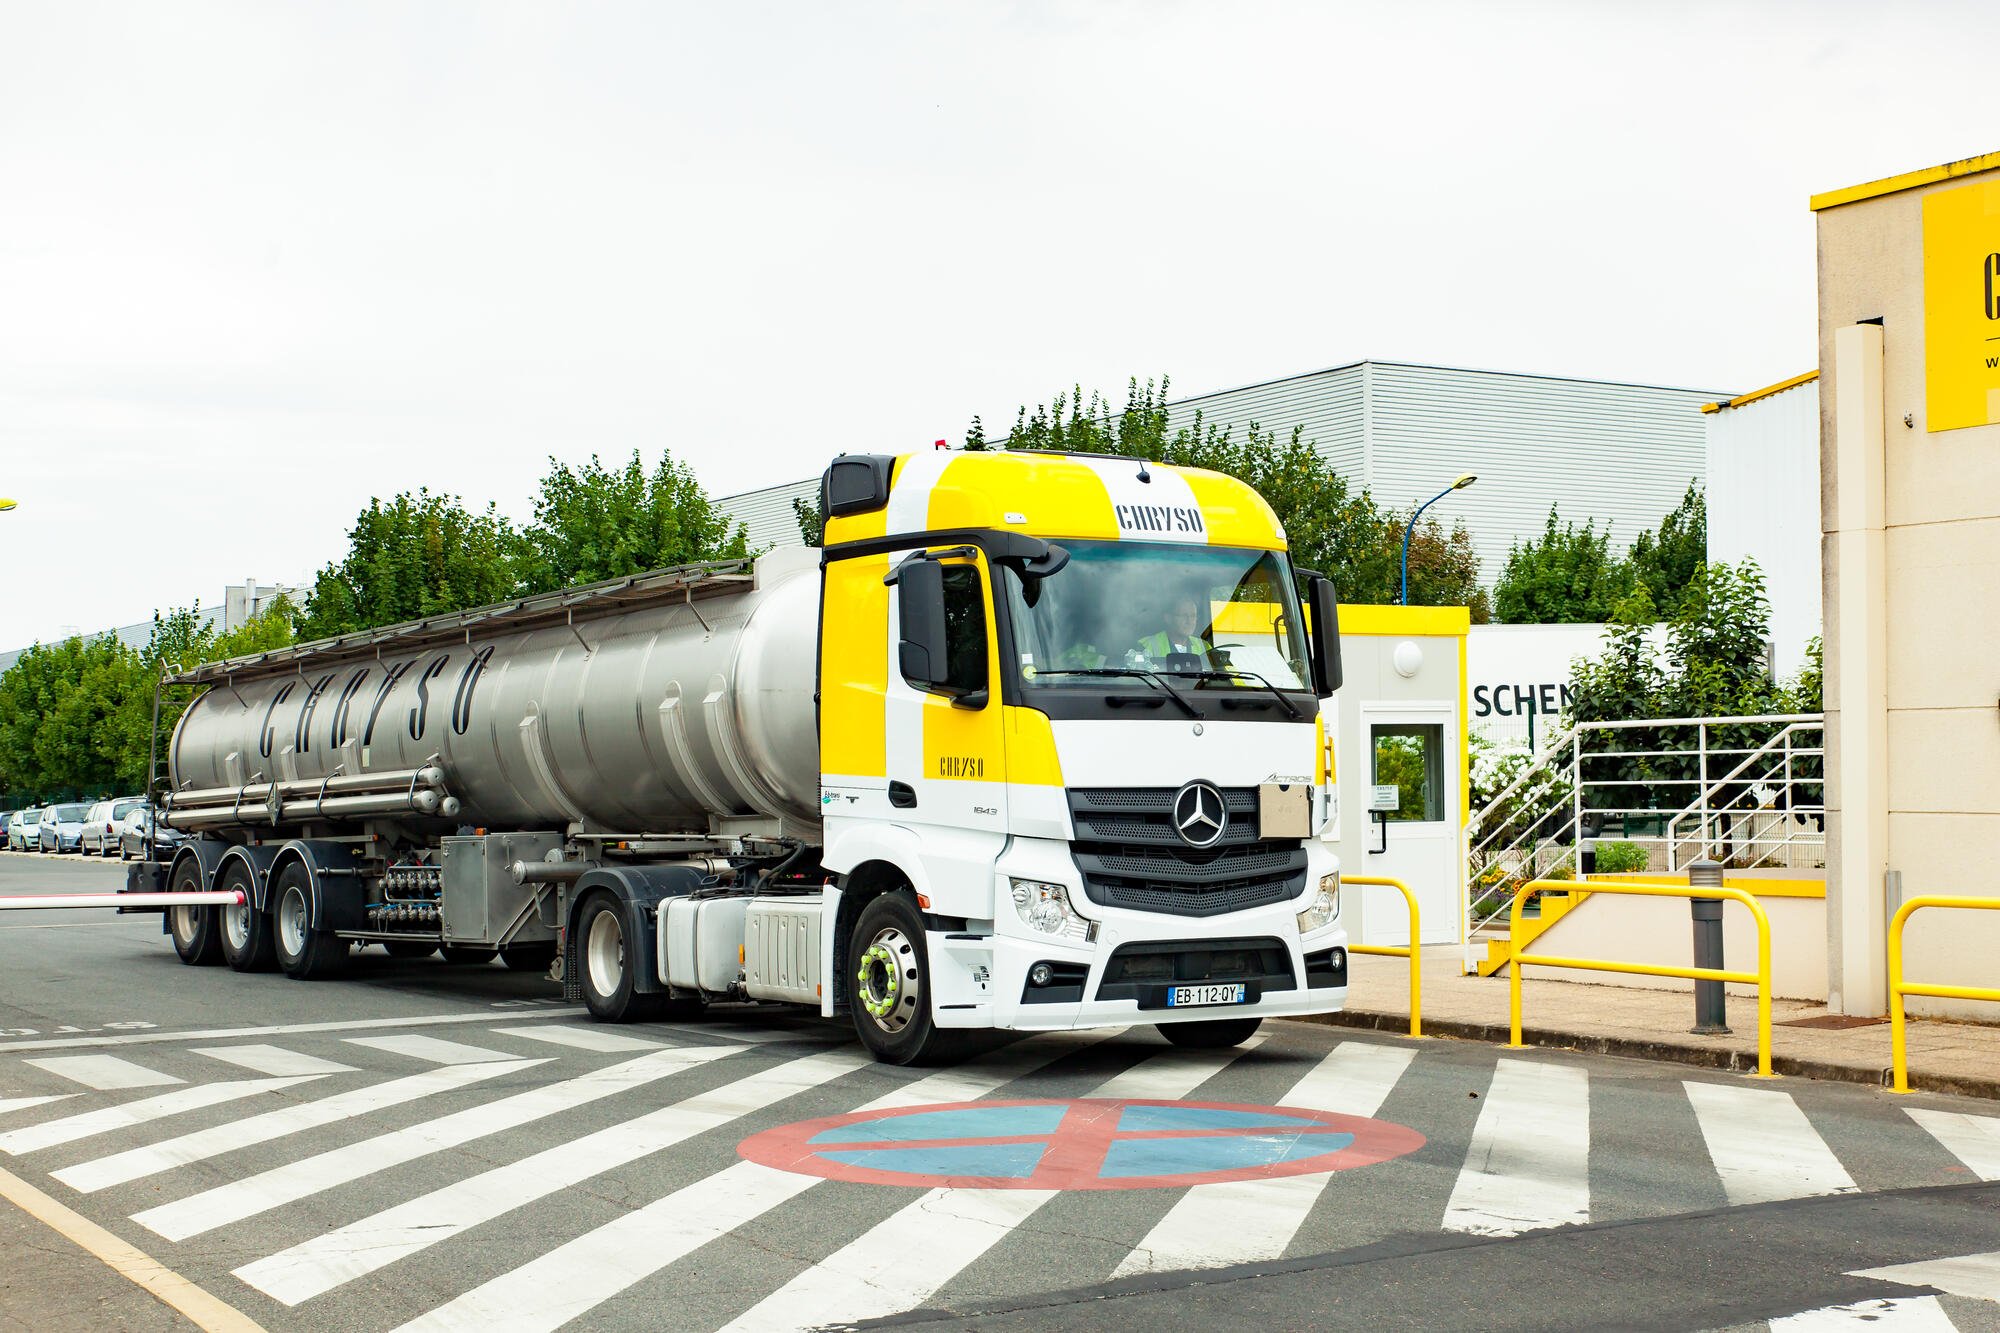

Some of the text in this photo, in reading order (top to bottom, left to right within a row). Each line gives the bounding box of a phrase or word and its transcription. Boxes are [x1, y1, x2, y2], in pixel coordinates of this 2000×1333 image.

[1115, 494, 1203, 533] CHRYSO
[260, 645, 496, 758] CHRYSO
[940, 756, 984, 777] CHRYSO
